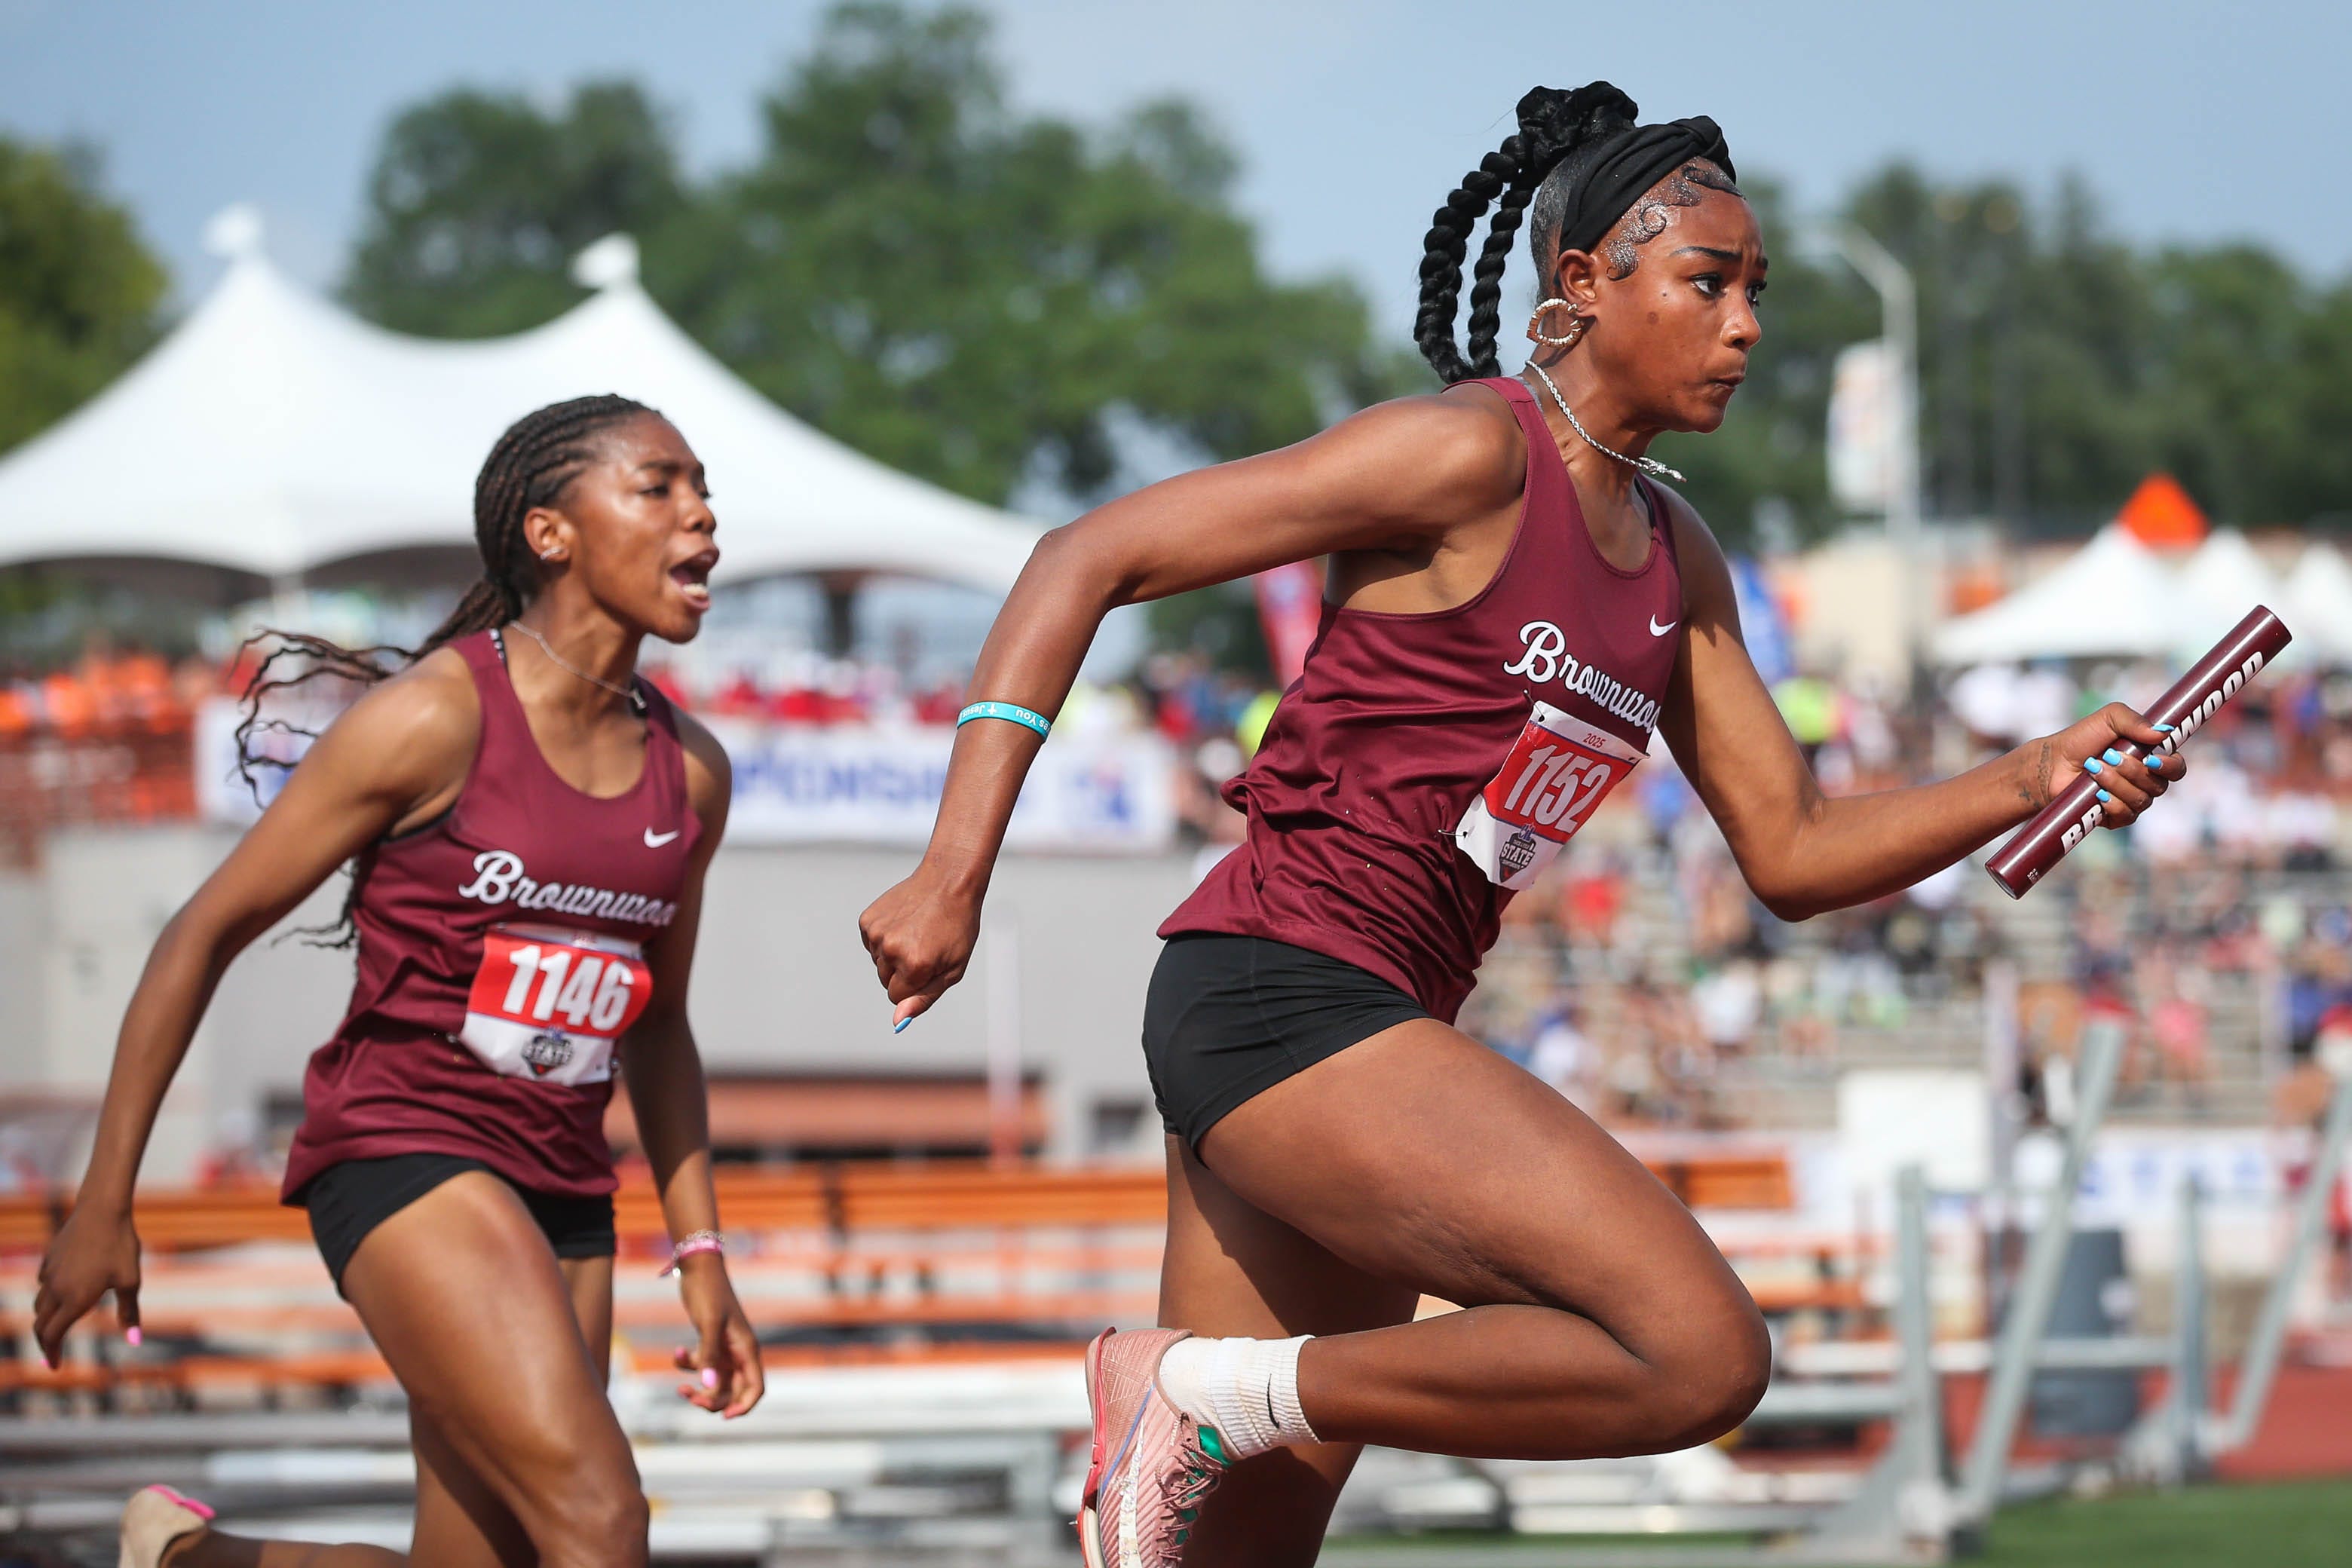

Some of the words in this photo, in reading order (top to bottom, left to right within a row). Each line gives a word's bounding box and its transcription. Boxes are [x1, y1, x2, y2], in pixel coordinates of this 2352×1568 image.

[962, 704, 985, 718] Jesus
[1503, 620, 1661, 734] Brownwoo
[1015, 709, 1037, 726] You
[1583, 733, 1606, 749] 2025
[2060, 651, 2264, 855] BRNWOOD
[1504, 744, 1612, 835] 1152
[458, 850, 678, 927] Brownwoo
[1501, 843, 1534, 866] STATE
[502, 945, 635, 1031] 1146
